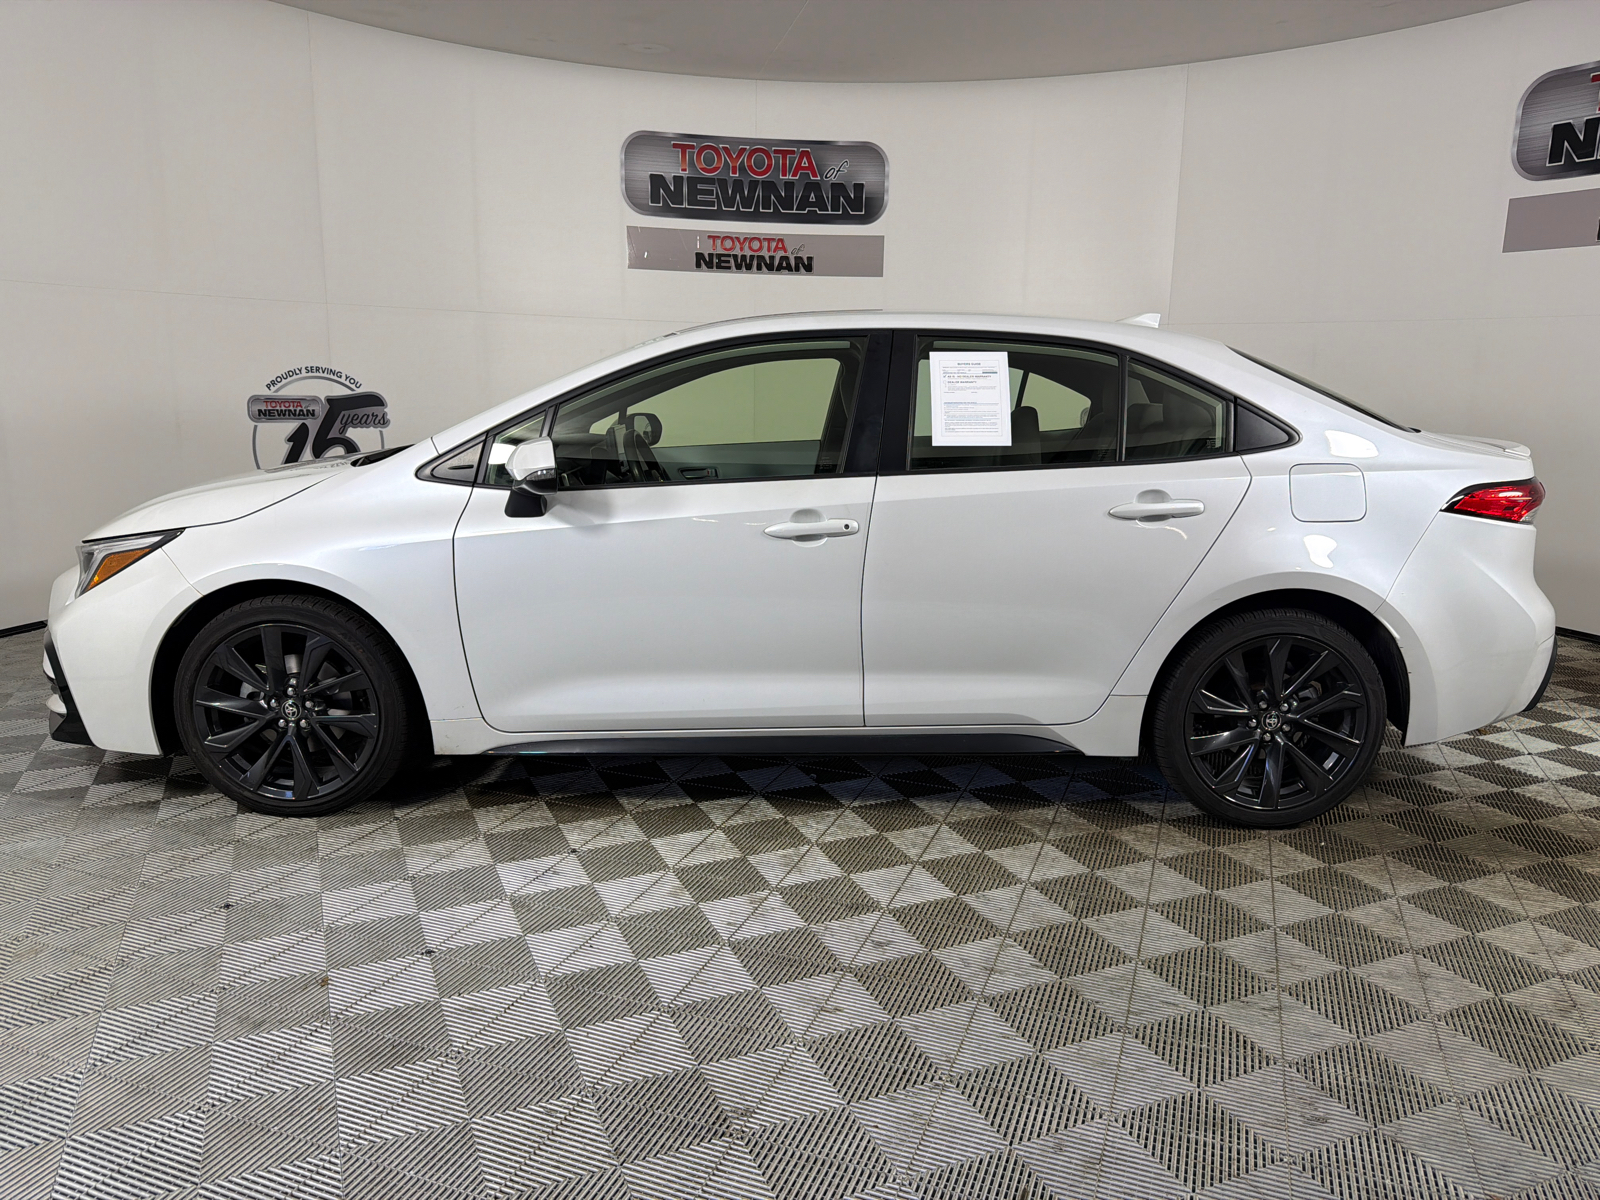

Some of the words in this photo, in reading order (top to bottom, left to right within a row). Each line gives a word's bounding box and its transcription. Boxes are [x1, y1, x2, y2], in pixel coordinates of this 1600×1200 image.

[1546, 115, 1600, 166] N
[671, 142, 820, 179] TOYOTA
[823, 160, 849, 180] of
[649, 174, 865, 214] NEWNAN
[707, 235, 788, 254] TOYOTA
[791, 244, 805, 255] of
[695, 252, 814, 273] NEWNAN
[265, 366, 303, 391] PROUDLY
[304, 366, 343, 379] SERVING
[344, 374, 362, 389] YOU
[257, 408, 316, 418] NEWNAN
[263, 400, 303, 409] TOYOTA
[339, 411, 389, 435] years
